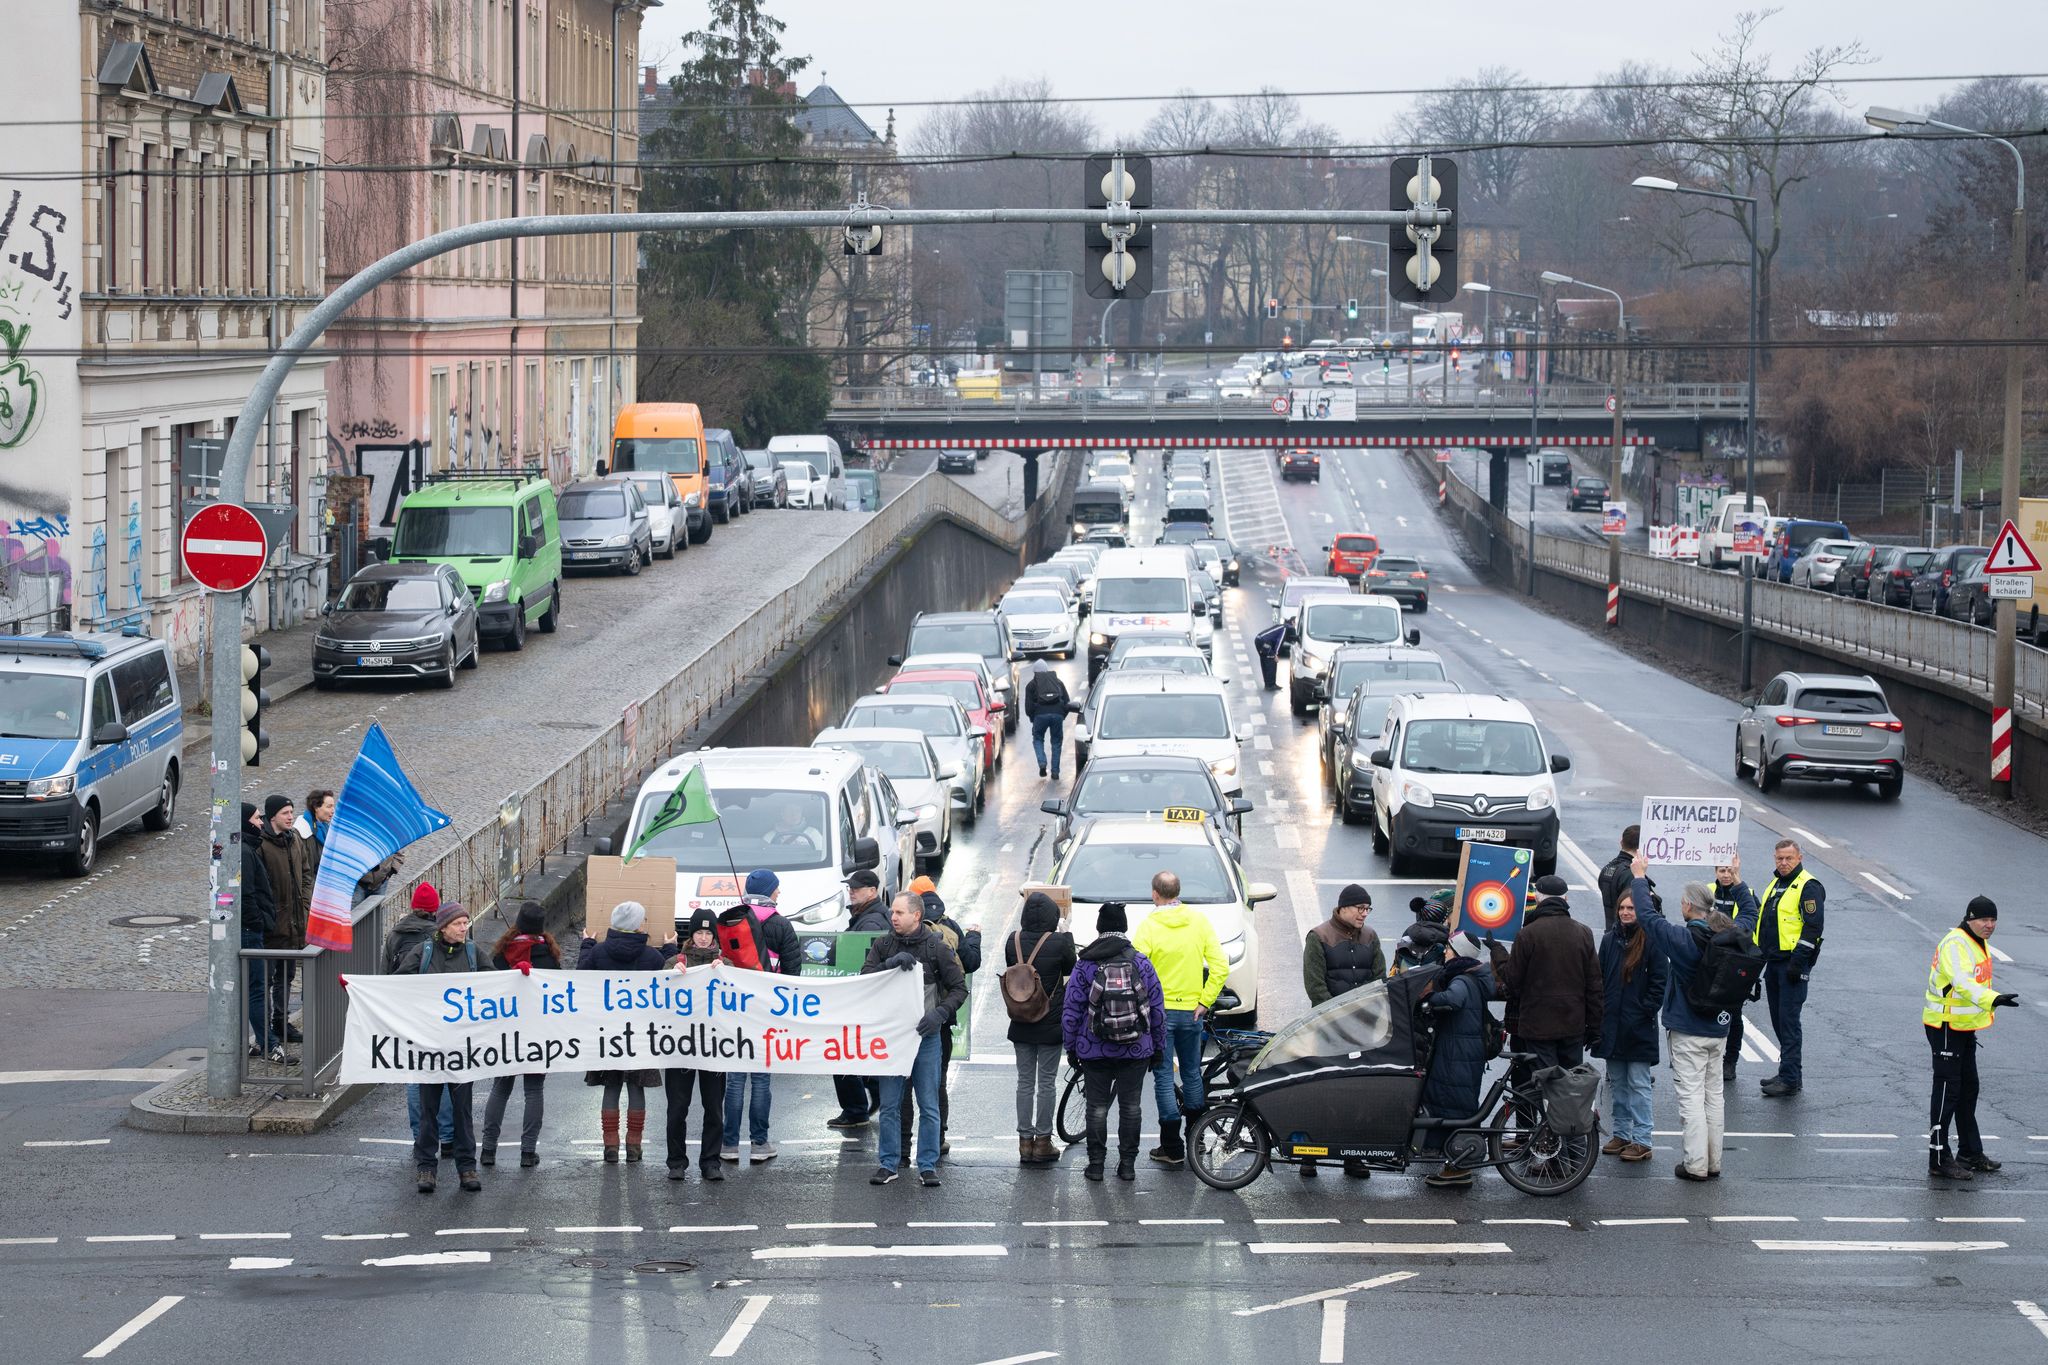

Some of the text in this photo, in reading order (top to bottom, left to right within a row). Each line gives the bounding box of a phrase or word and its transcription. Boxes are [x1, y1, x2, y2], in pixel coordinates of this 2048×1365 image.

[1994, 578, 2028, 586] Straßen-
[1995, 587, 2027, 595] schäden
[1108, 616, 1171, 627] FedEx
[130, 739, 149, 760] POLIZEI
[1170, 809, 1198, 820] TAXI
[1651, 805, 1738, 823] KLIMAGELD
[1461, 828, 1471, 838] DD
[1486, 830, 1505, 839] 4328
[1697, 825, 1717, 834] und
[705, 899, 742, 907] Maltes
[442, 976, 821, 1022] Stau ist lästig für Sie
[371, 1021, 889, 1070] Klimakollaps ist tödlich für alle
